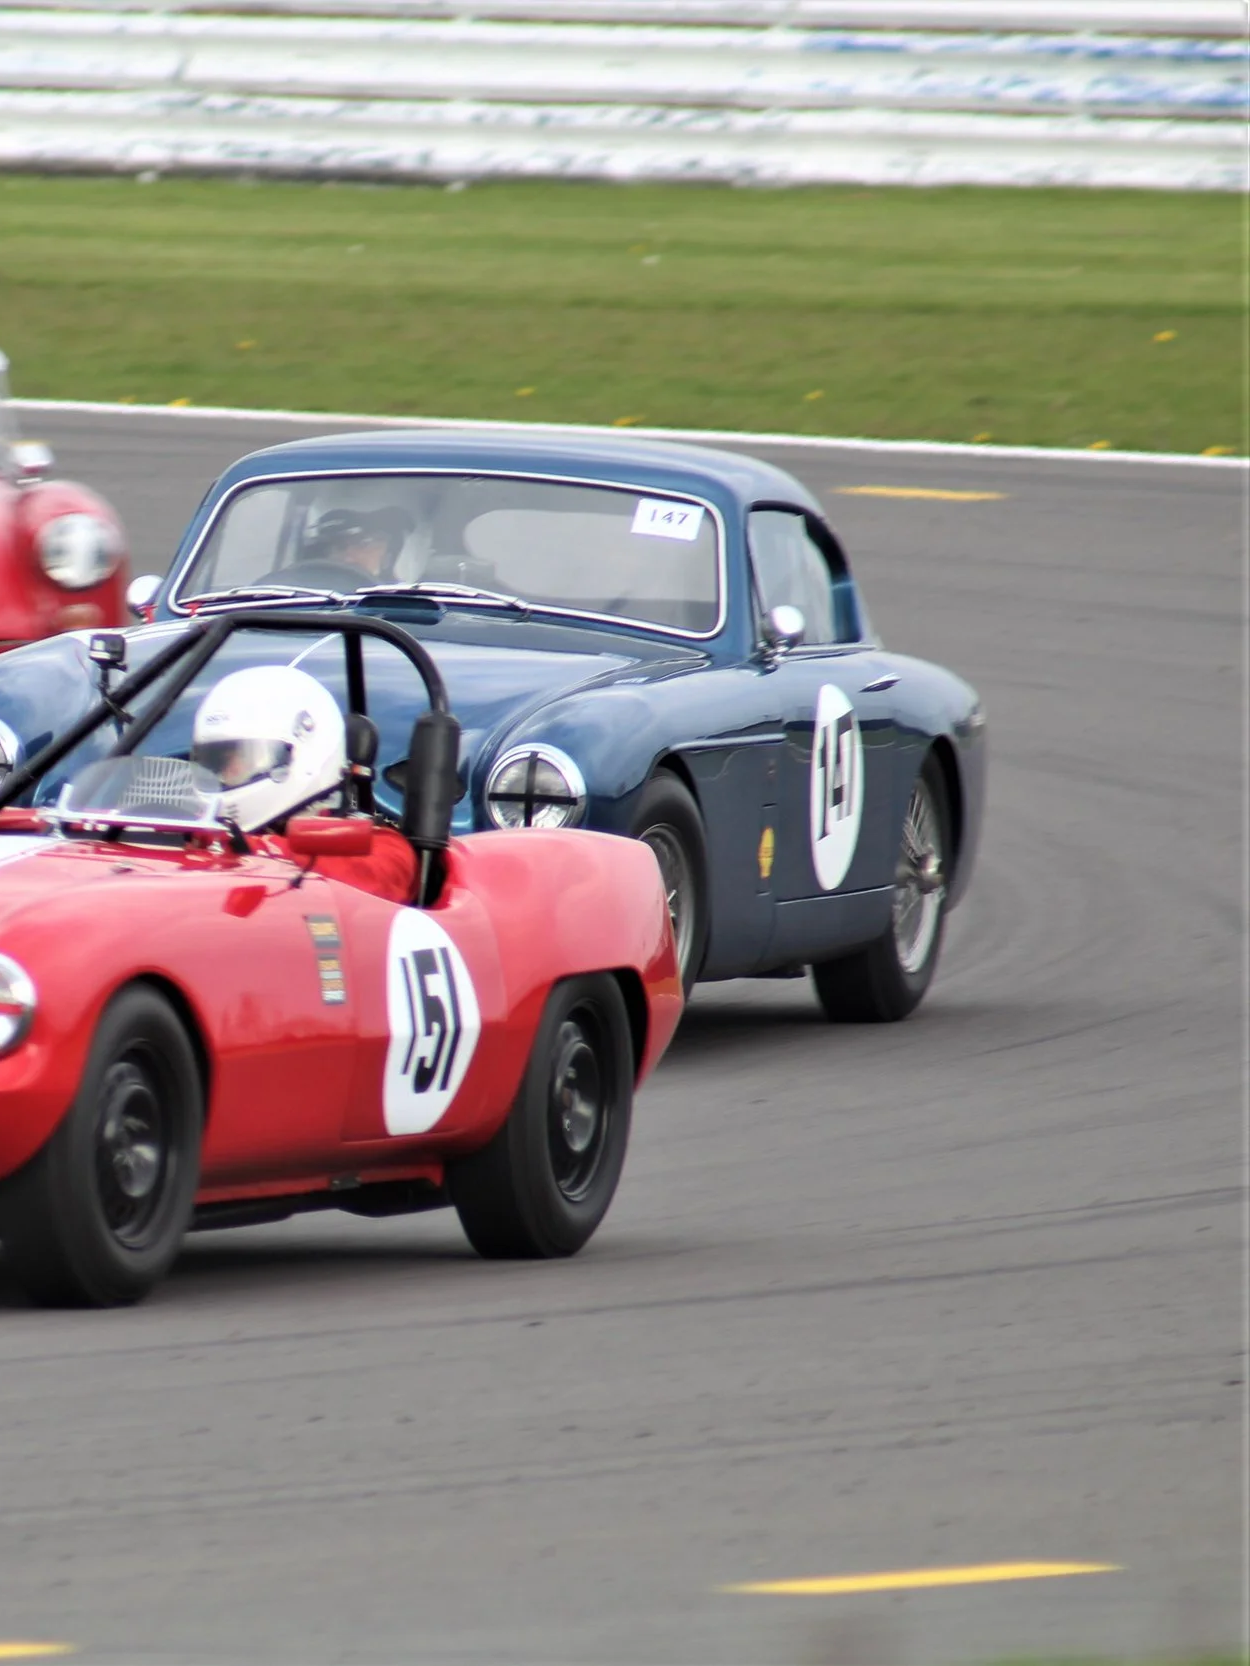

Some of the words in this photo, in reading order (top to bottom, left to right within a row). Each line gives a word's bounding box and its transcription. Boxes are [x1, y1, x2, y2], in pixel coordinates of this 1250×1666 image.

[650, 508, 690, 525] 147
[813, 709, 854, 843] 147
[399, 946, 464, 1094] 151
